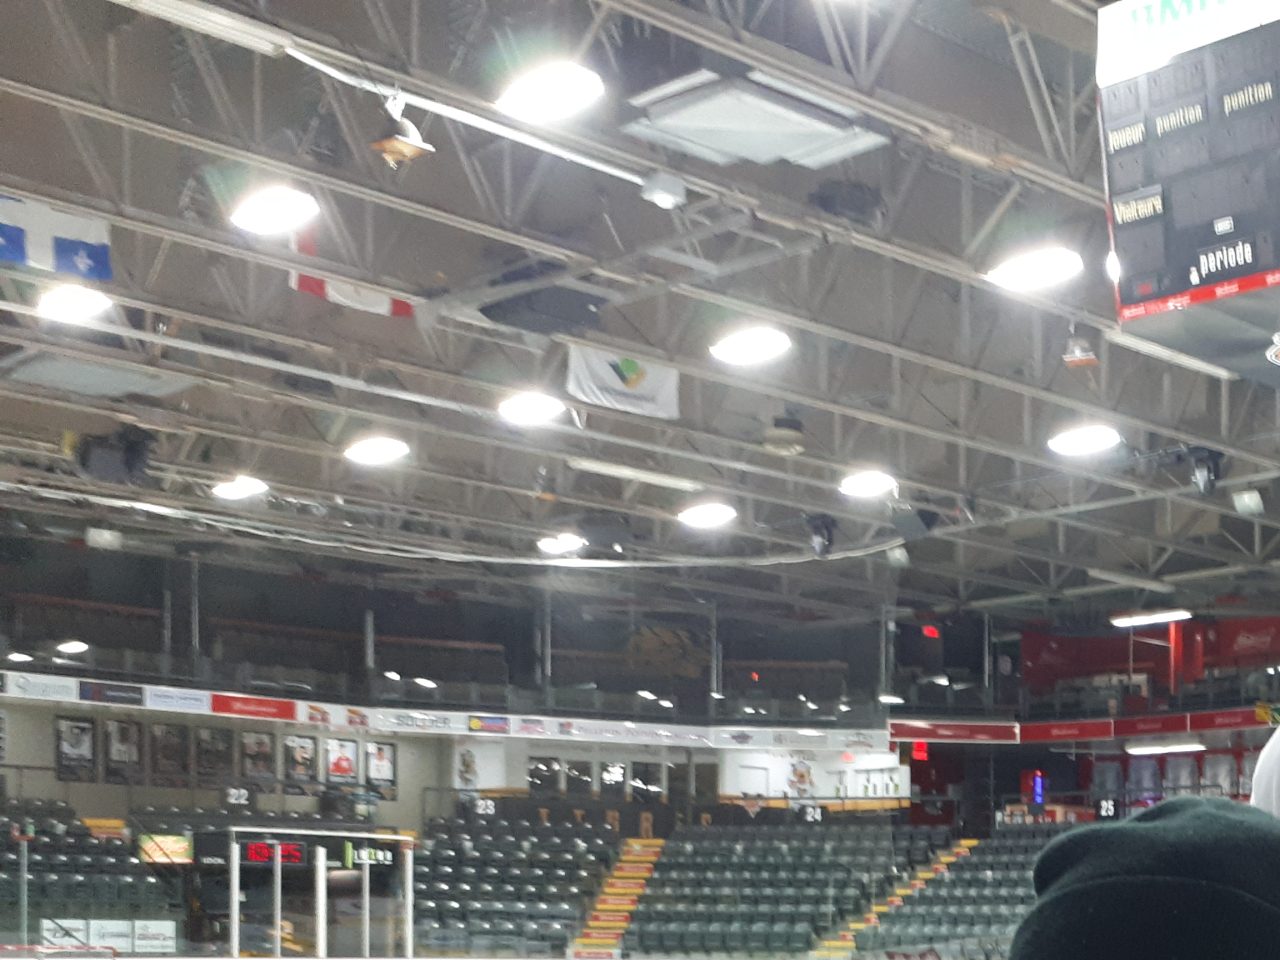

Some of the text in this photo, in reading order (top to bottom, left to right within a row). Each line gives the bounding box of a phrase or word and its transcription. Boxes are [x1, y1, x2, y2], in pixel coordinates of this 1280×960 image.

[1223, 82, 1273, 117] punition
[1156, 104, 1203, 137] punition
[226, 788, 249, 804] 22
[476, 799, 496, 815] 23
[805, 807, 822, 822] 24
[1100, 800, 1115, 816] 25
